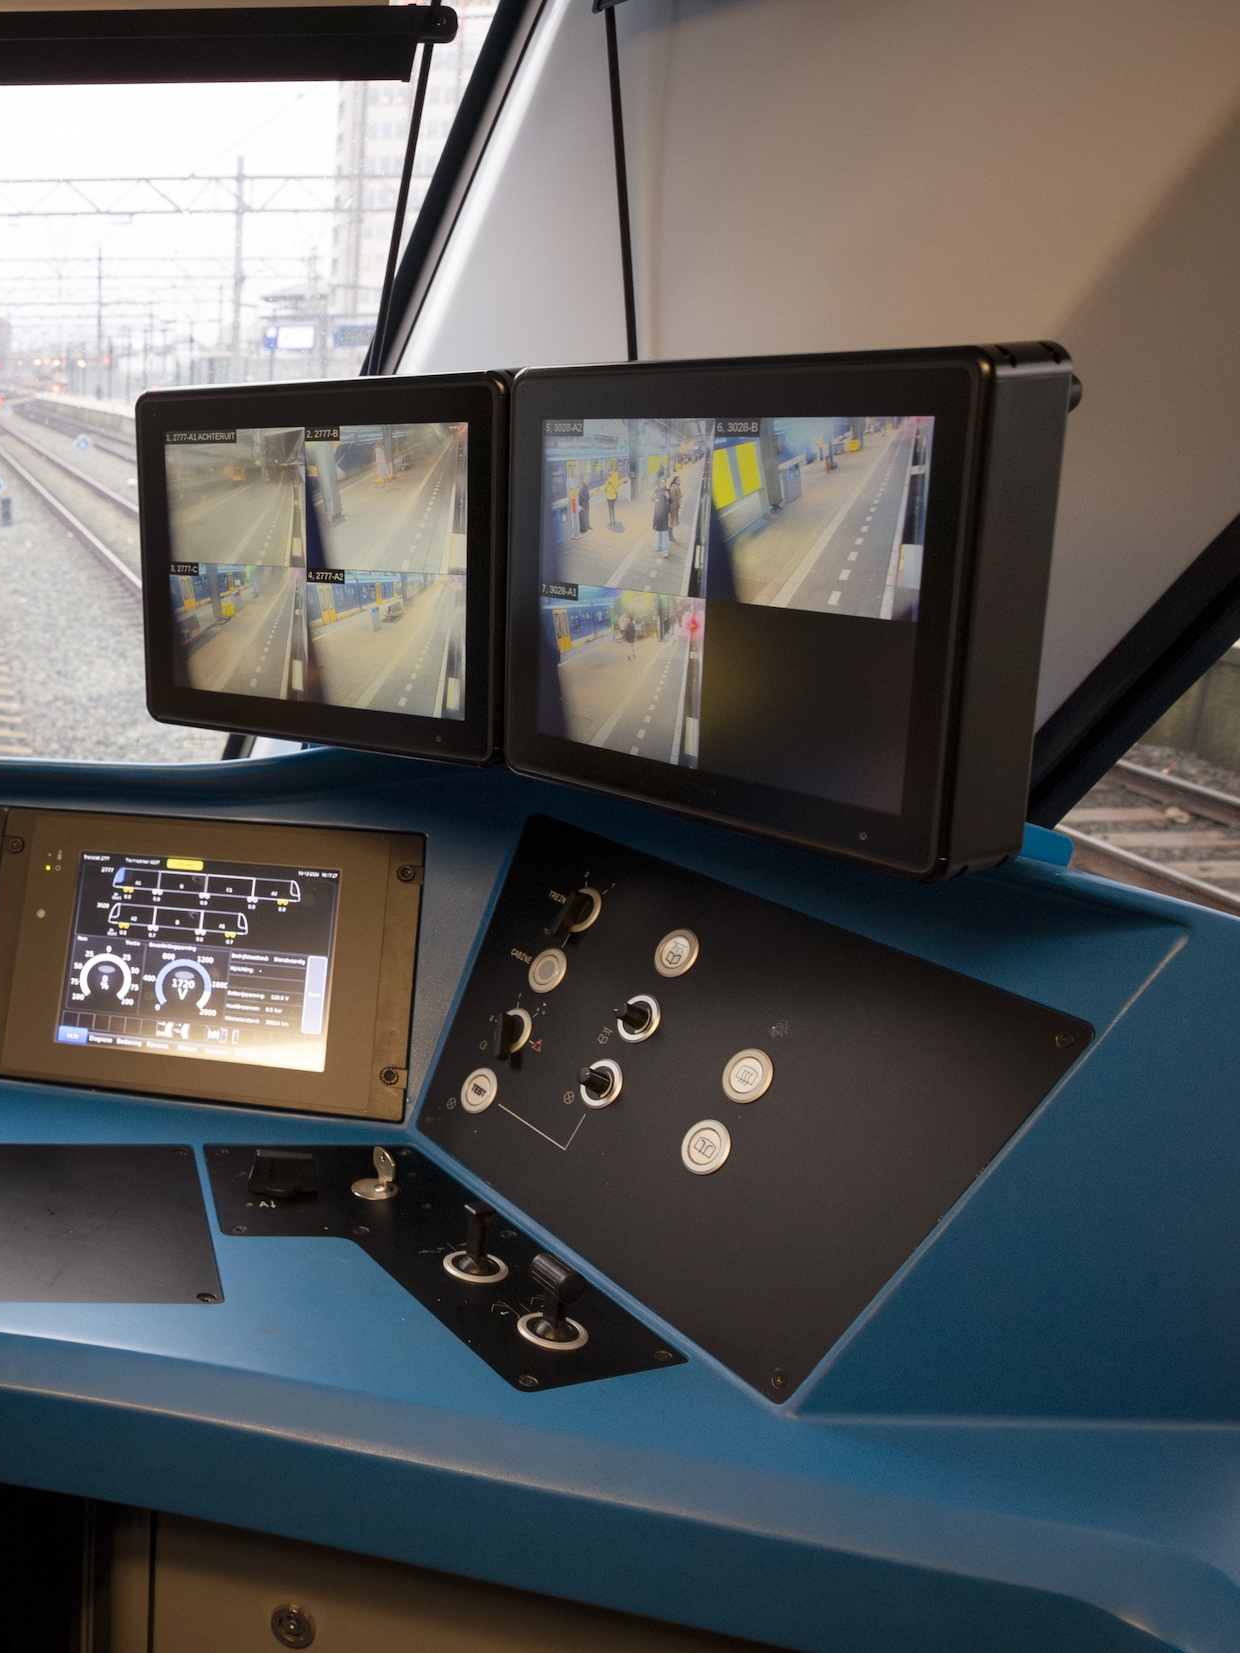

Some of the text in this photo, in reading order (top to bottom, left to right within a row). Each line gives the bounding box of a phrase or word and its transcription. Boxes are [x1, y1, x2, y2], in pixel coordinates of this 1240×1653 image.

[554, 423, 582, 432] 3028-A2
[727, 422, 758, 432] 3028-B
[172, 433, 197, 442] 2777-A1
[198, 432, 236, 440] ACHTERUIT
[314, 430, 338, 438] 2777-B
[177, 565, 198, 573] 2777-C
[316, 572, 344, 581] 2777-A2
[550, 585, 576, 596] 3028-A1
[549, 890, 568, 904] TREIN
[106, 945, 112, 953] 0
[162, 952, 176, 960] 800
[197, 956, 214, 964] 1200
[510, 948, 533, 964] CABINE
[73, 962, 83, 970] 50
[70, 978, 79, 986] 75
[172, 978, 195, 989] 1720
[72, 992, 85, 1001] 100
[178, 988, 188, 1000] V
[121, 998, 134, 1006] 100
[471, 1083, 487, 1098] TEST
